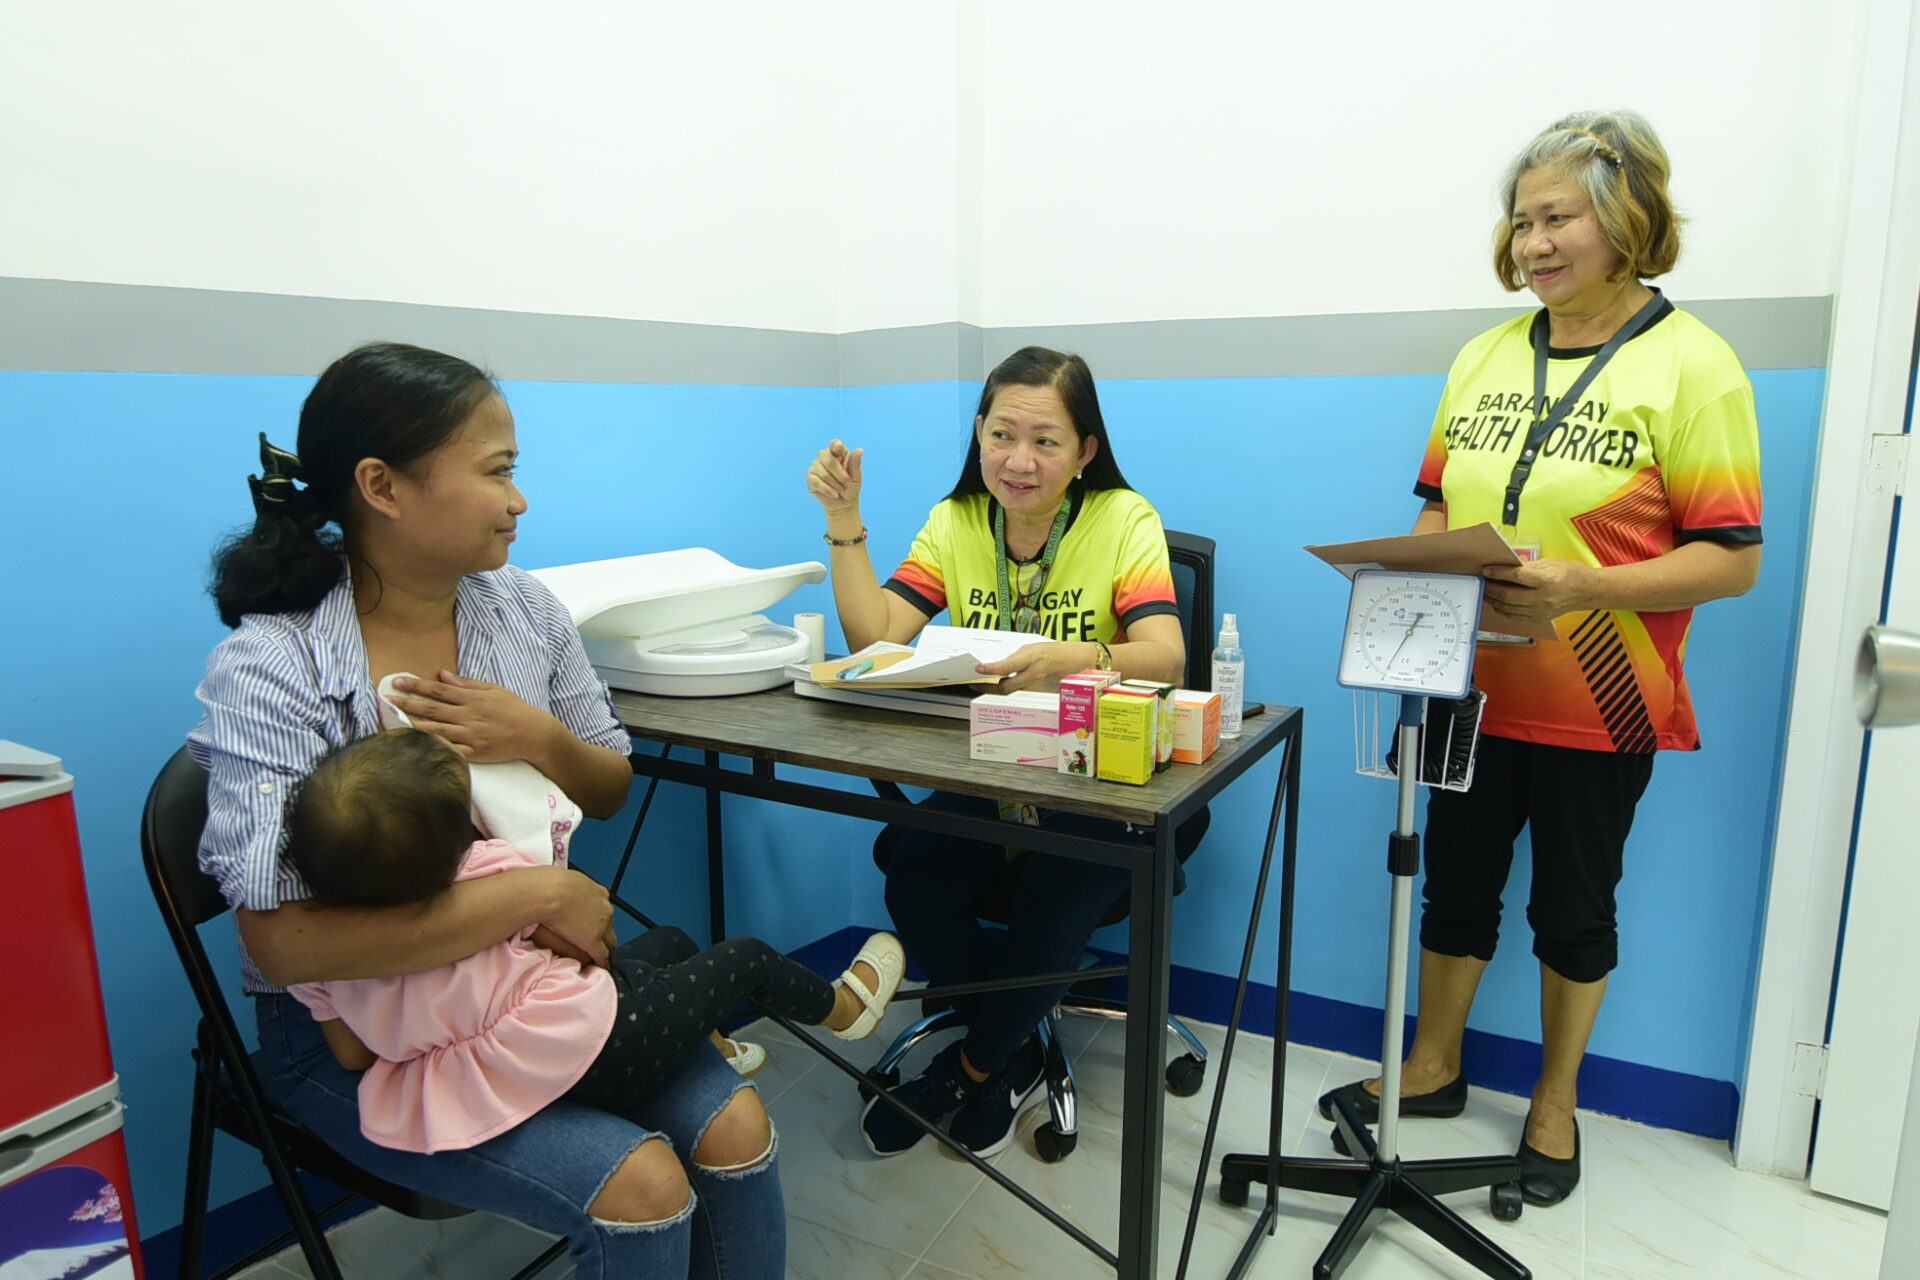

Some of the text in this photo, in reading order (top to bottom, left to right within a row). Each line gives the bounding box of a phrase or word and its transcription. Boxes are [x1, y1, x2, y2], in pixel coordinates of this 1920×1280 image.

[1476, 392, 1610, 424] BARANAY
[1527, 419, 1639, 469] ORKER
[969, 588, 1083, 611] BAGAY
[966, 609, 1097, 642] IIFE
